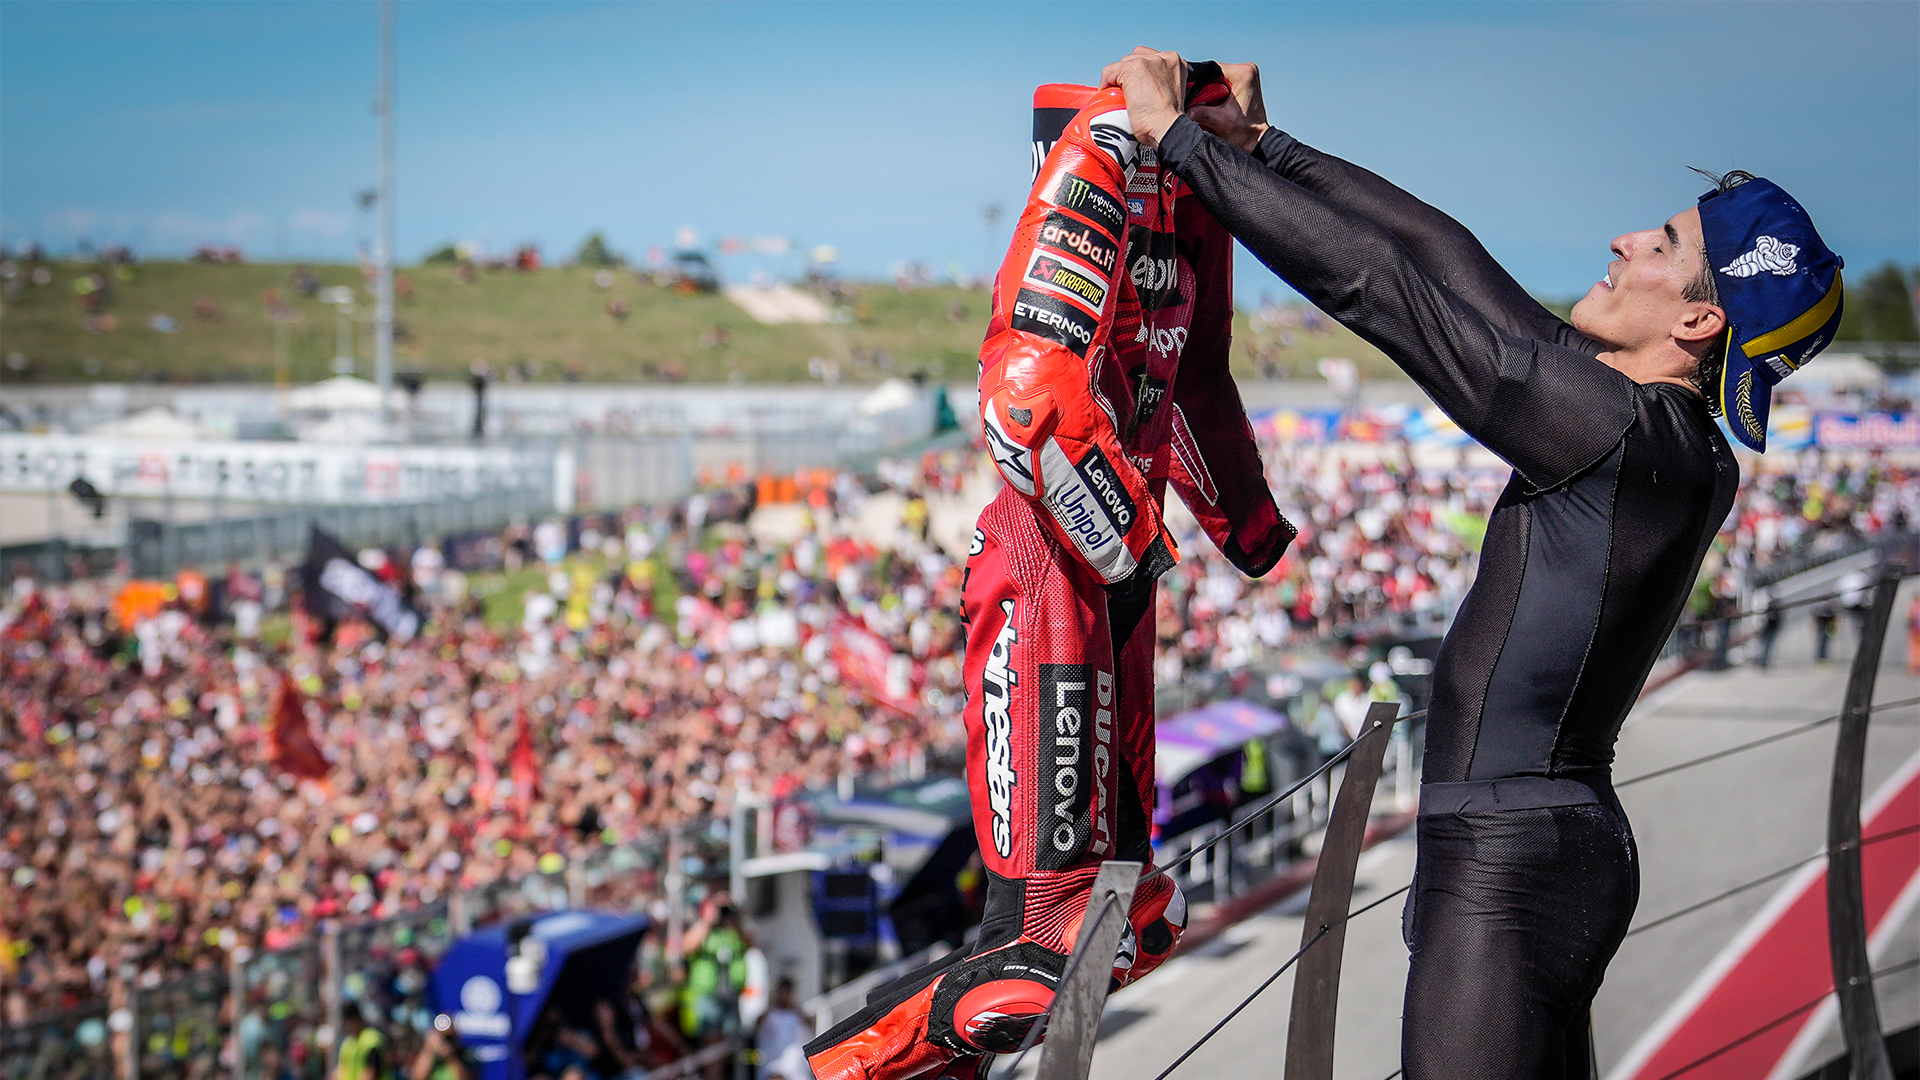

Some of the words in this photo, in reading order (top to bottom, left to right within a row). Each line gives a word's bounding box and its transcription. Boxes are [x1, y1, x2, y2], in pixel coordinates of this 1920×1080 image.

[1088, 192, 1123, 224] MONSTER
[1043, 225, 1115, 271] aruba.it
[1060, 483, 1113, 550] Unipol
[1083, 455, 1130, 525] Lenovo
[1053, 682, 1086, 851] Lenovo
[1091, 669, 1113, 855] DUCATI
